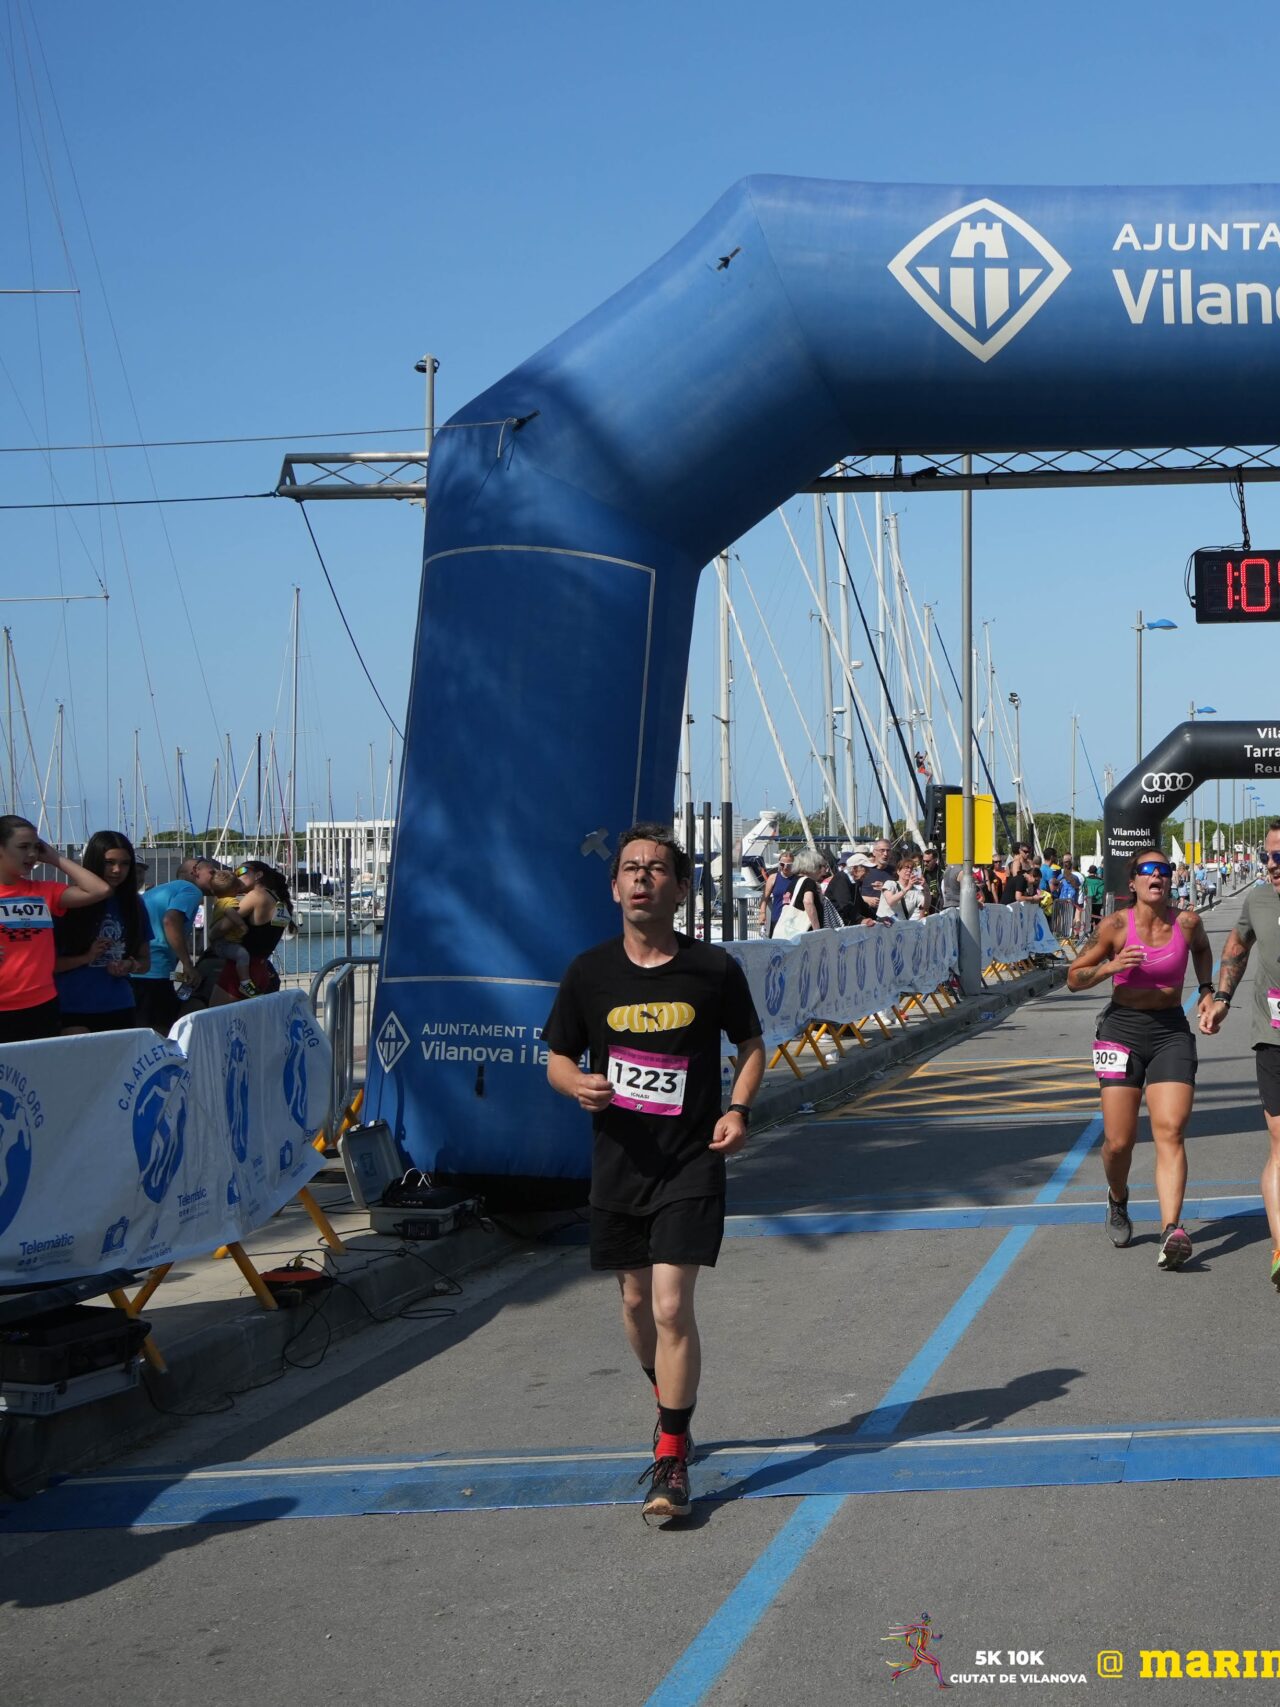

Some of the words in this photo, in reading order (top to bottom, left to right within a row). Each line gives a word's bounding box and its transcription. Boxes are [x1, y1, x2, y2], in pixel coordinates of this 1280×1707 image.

[1140, 794, 1165, 804] Audi
[1112, 827, 1151, 837] Vilamòbil
[1107, 837, 1156, 847] Tarracomòbil
[0, 904, 44, 917] 1407
[421, 1023, 527, 1039] AJUNTAMENT
[533, 1027, 543, 1040] D
[421, 1041, 513, 1062] Vilanova
[615, 1062, 678, 1094] 1223
